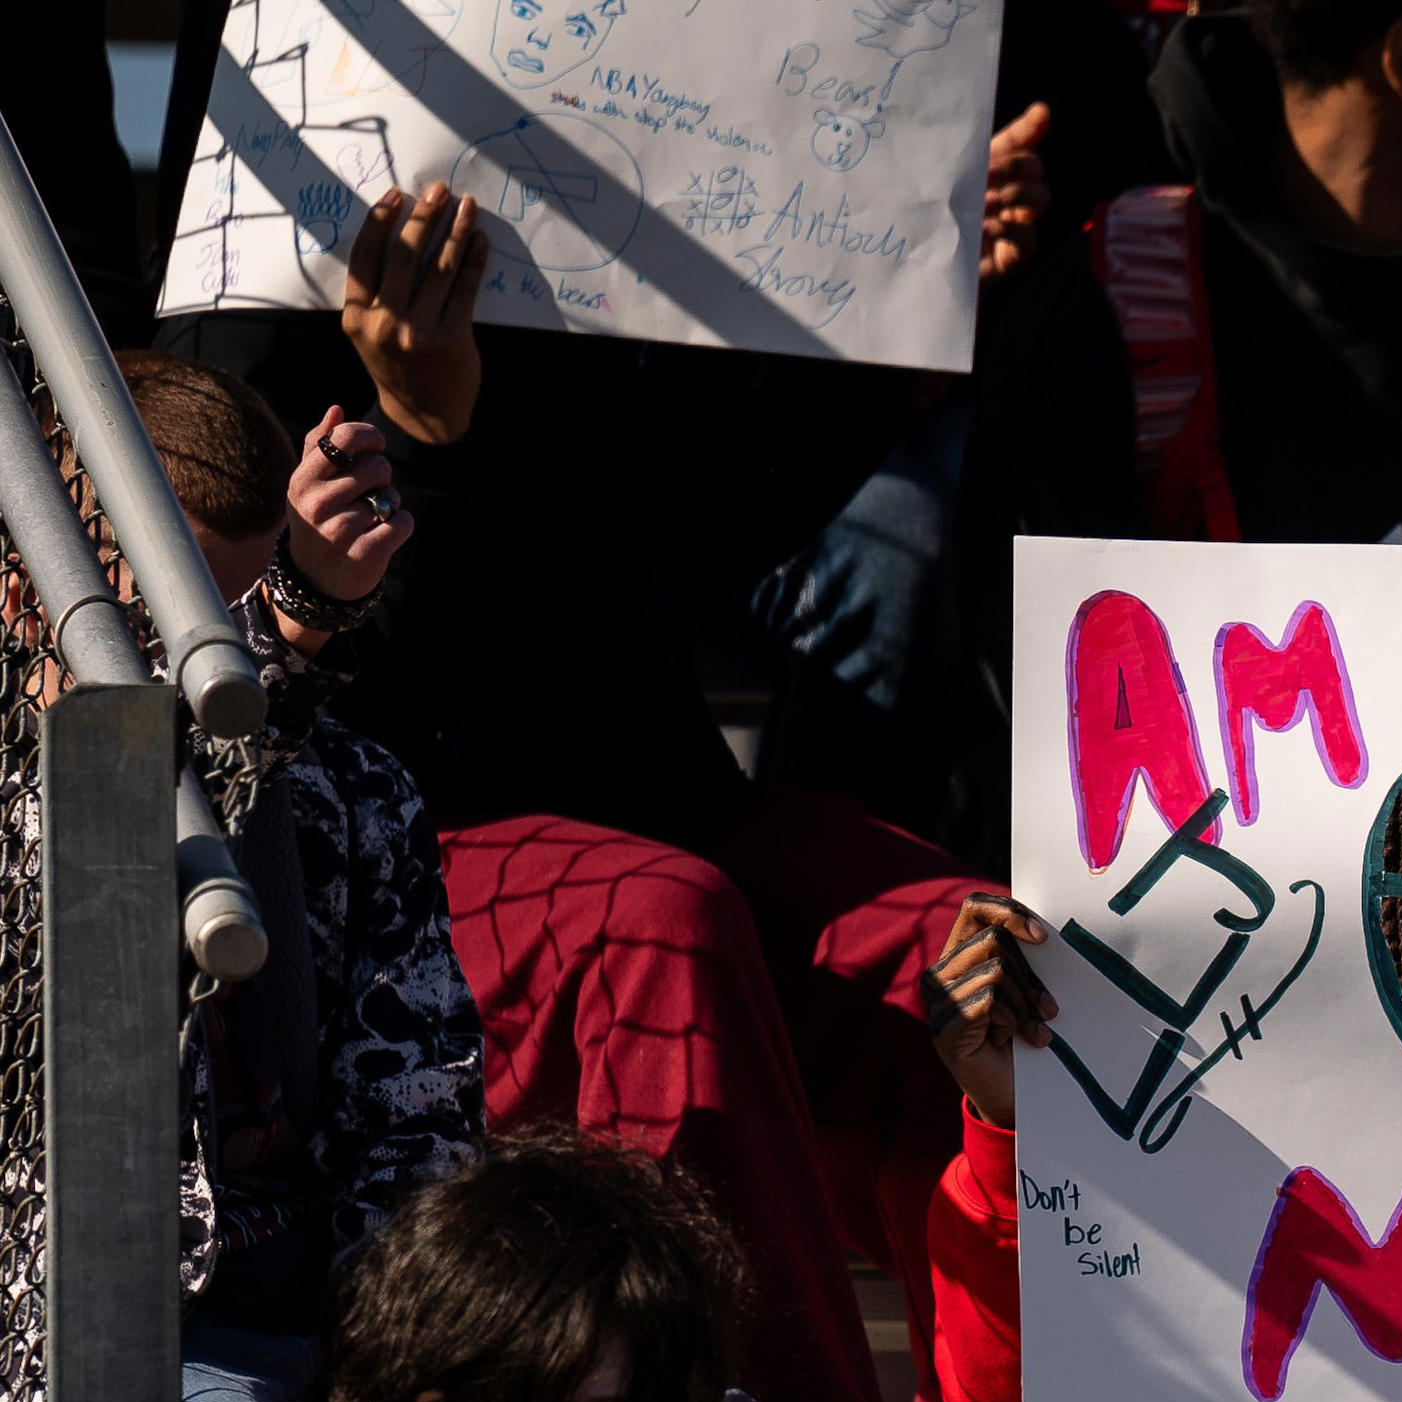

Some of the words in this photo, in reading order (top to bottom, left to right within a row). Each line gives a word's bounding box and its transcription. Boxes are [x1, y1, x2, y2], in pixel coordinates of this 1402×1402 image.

[1066, 588, 1369, 875] AM
[1020, 1168, 1082, 1213] Don't
[1064, 1216, 1102, 1247] be
[1077, 1242, 1141, 1279] Silent
